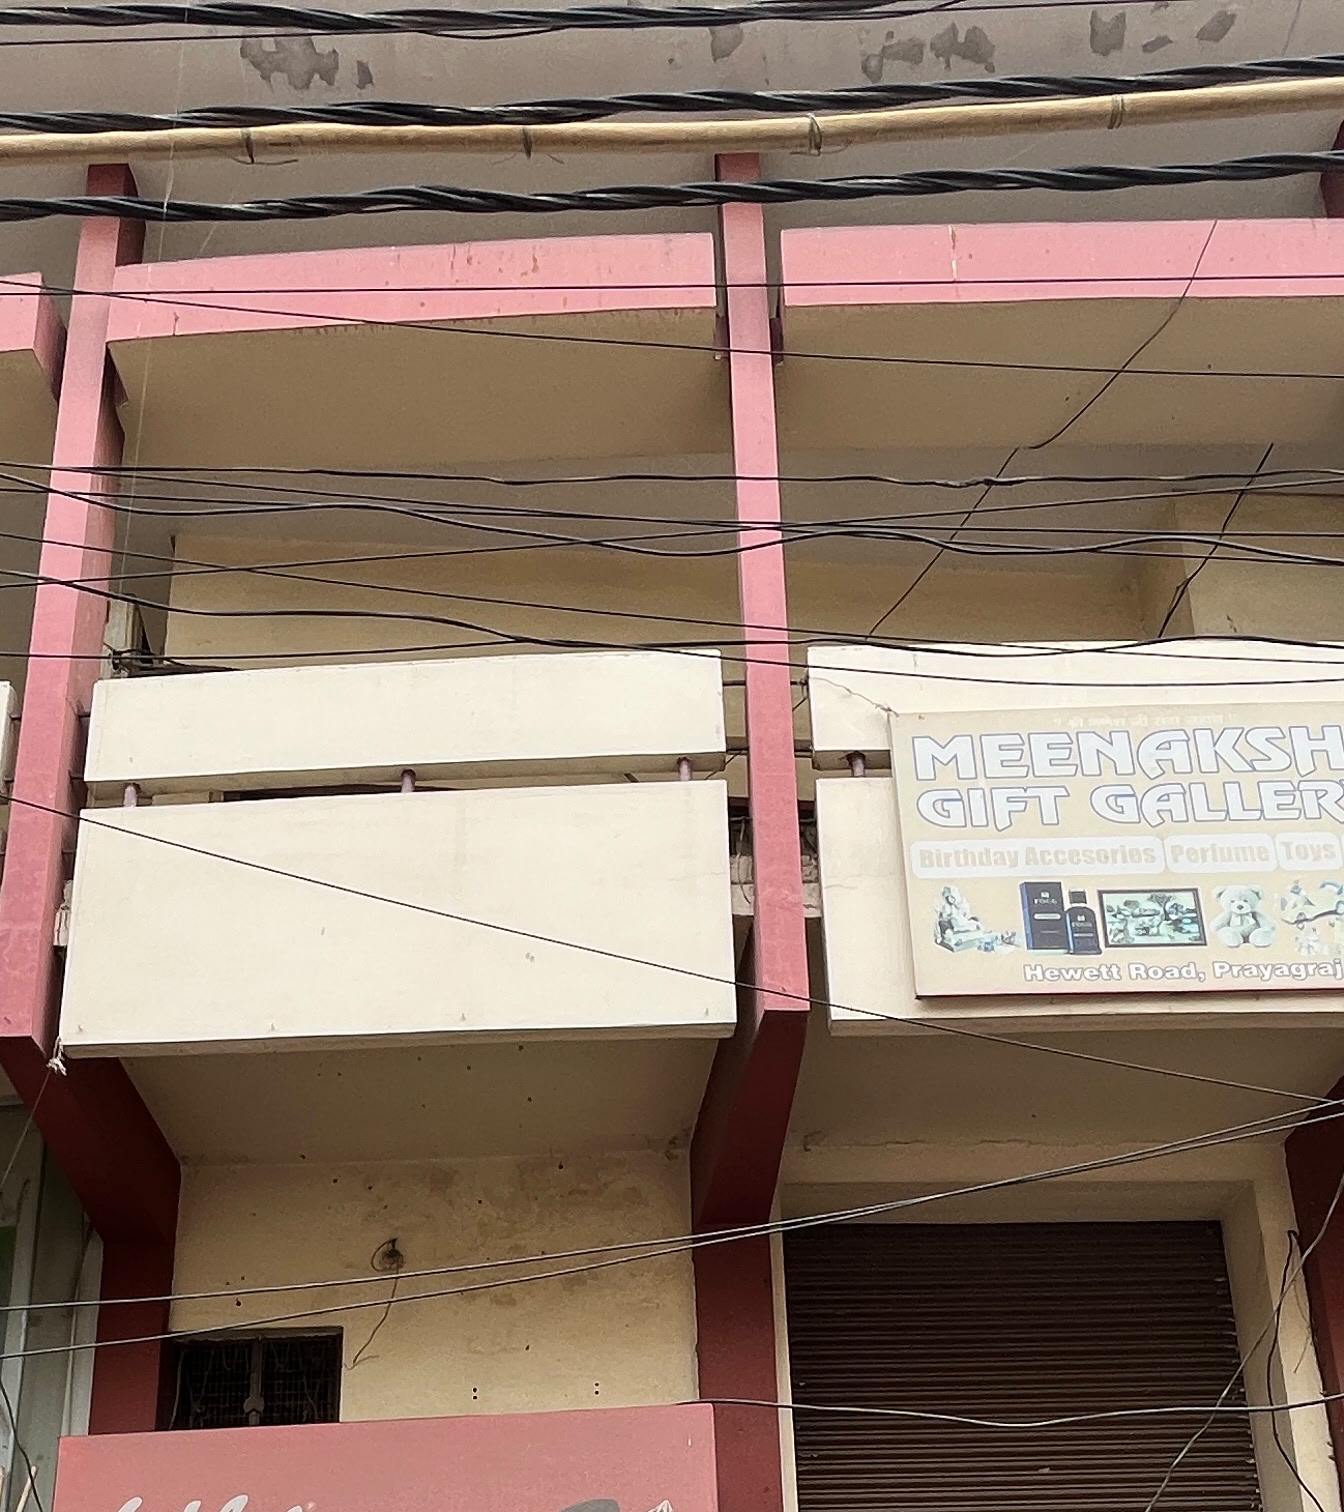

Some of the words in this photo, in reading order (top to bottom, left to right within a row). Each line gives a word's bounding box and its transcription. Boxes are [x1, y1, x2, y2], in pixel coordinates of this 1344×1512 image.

[916, 786, 1069, 833] GIFT
[918, 845, 1019, 870] Birthday
[1024, 841, 1157, 867] Accesories
[1171, 841, 1270, 864] Perfume
[1280, 839, 1337, 864] Toys
[1023, 962, 1122, 984] Hewett
[1129, 961, 1206, 982] Road,
[1214, 957, 1344, 982] Prayagraj
